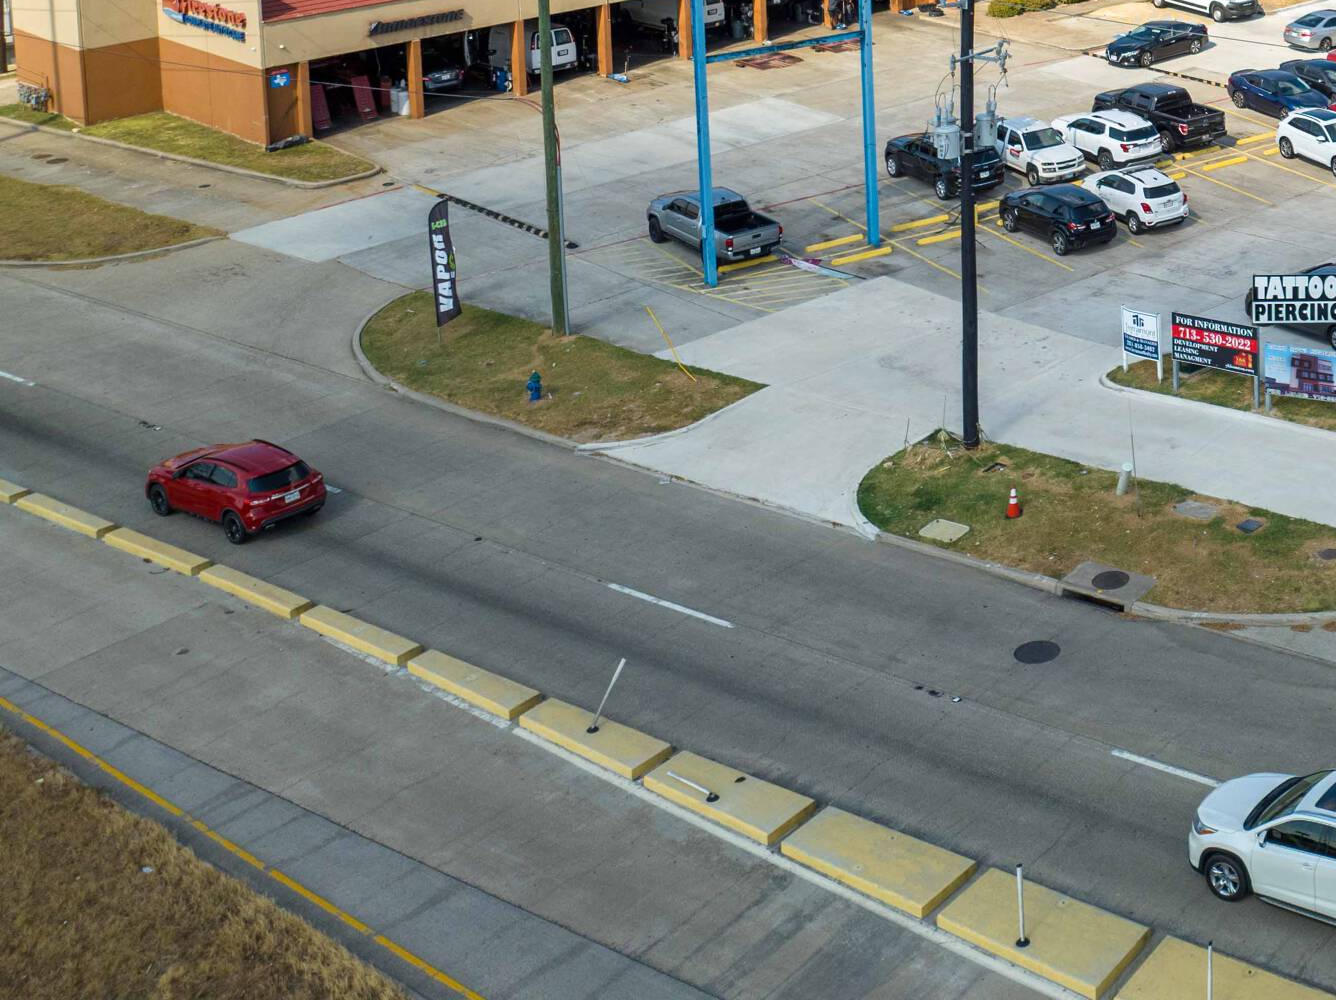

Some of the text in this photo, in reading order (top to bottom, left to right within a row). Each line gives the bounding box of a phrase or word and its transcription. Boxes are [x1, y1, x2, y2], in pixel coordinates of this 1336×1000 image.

[431, 234, 454, 312] VAPOR
[1175, 316, 1253, 337] FOR INFORMATION
[1174, 338, 1218, 353] DEVELOPMENT
[1203, 331, 1251, 351] 530-2022
[1174, 345, 1199, 355] LEASING
[1174, 352, 1212, 365] MANAGMENT
